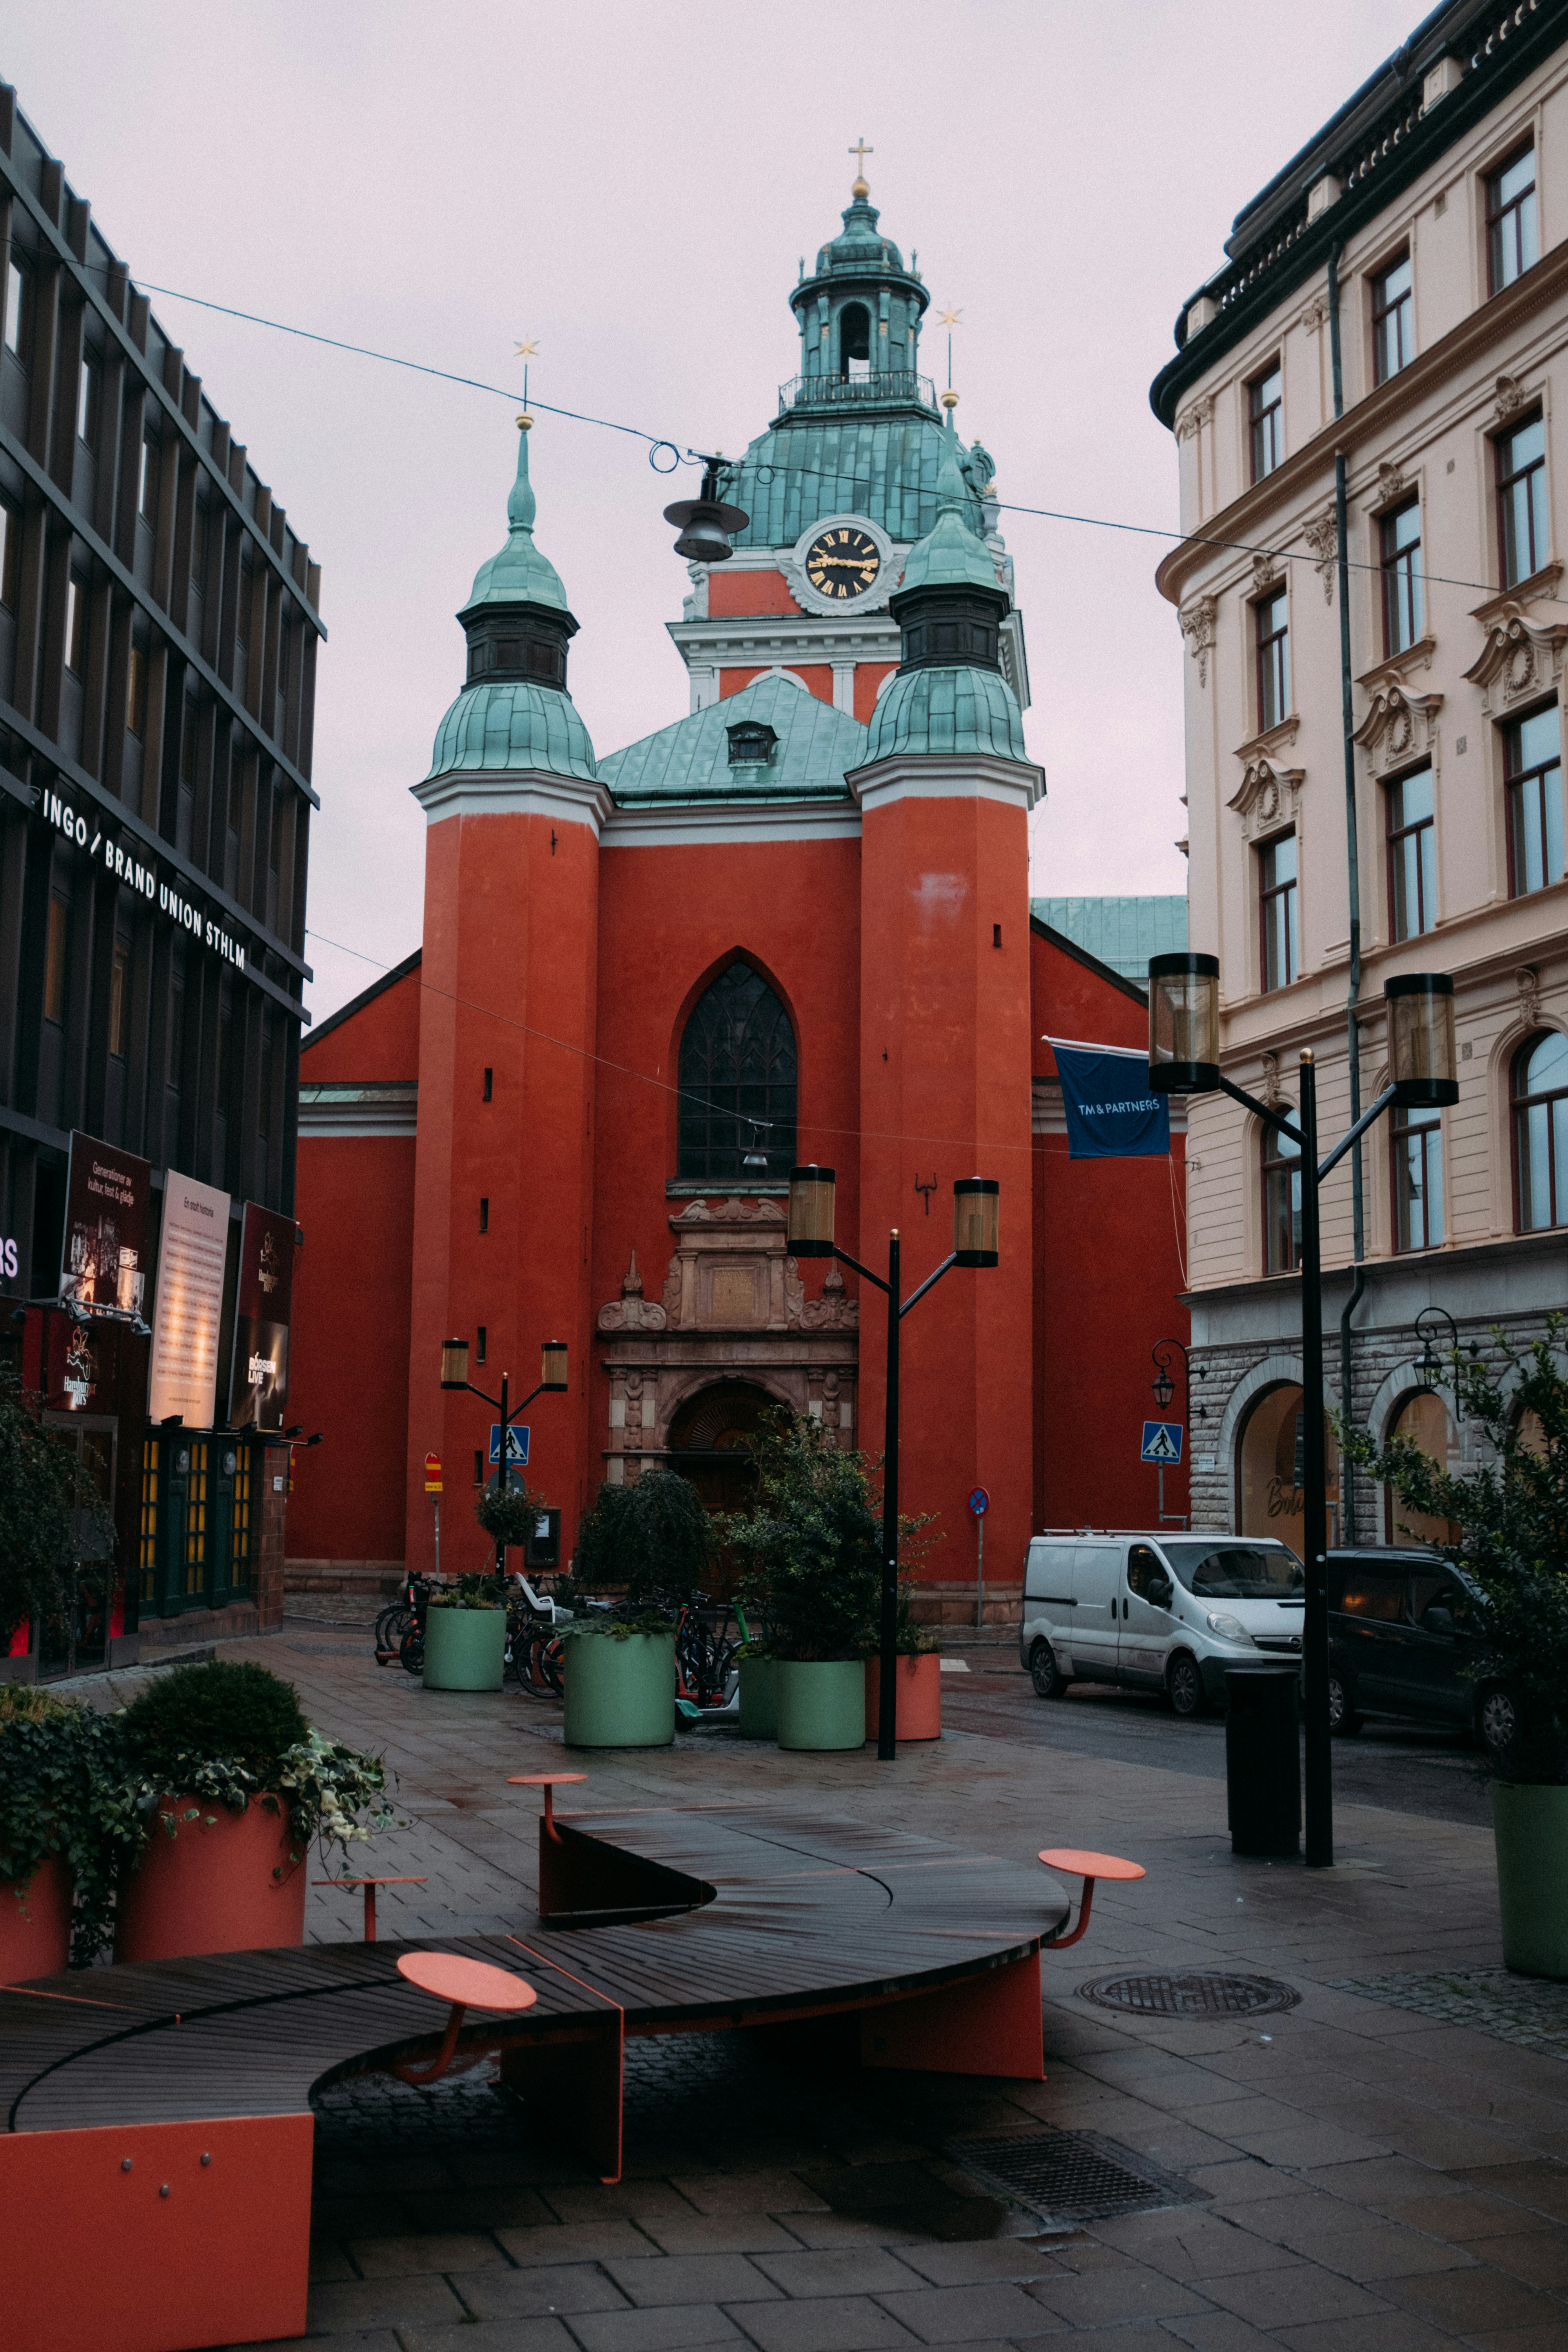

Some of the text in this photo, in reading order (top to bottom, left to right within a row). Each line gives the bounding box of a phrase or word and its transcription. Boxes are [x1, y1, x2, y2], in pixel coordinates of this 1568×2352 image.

[822, 533, 836, 548] XI
[838, 530, 849, 543] XII
[853, 534, 862, 546] I
[853, 581, 863, 593] V
[43, 789, 245, 970] INGO / BRAND UNION STHLM
[1078, 1099, 1160, 1115] TM & PARTNERS
[93, 1161, 132, 1187] Generationer av
[88, 1176, 134, 1207] kultur, fest & glädje
[184, 1197, 189, 1209] En
[248, 1370, 263, 1385] LIVE
